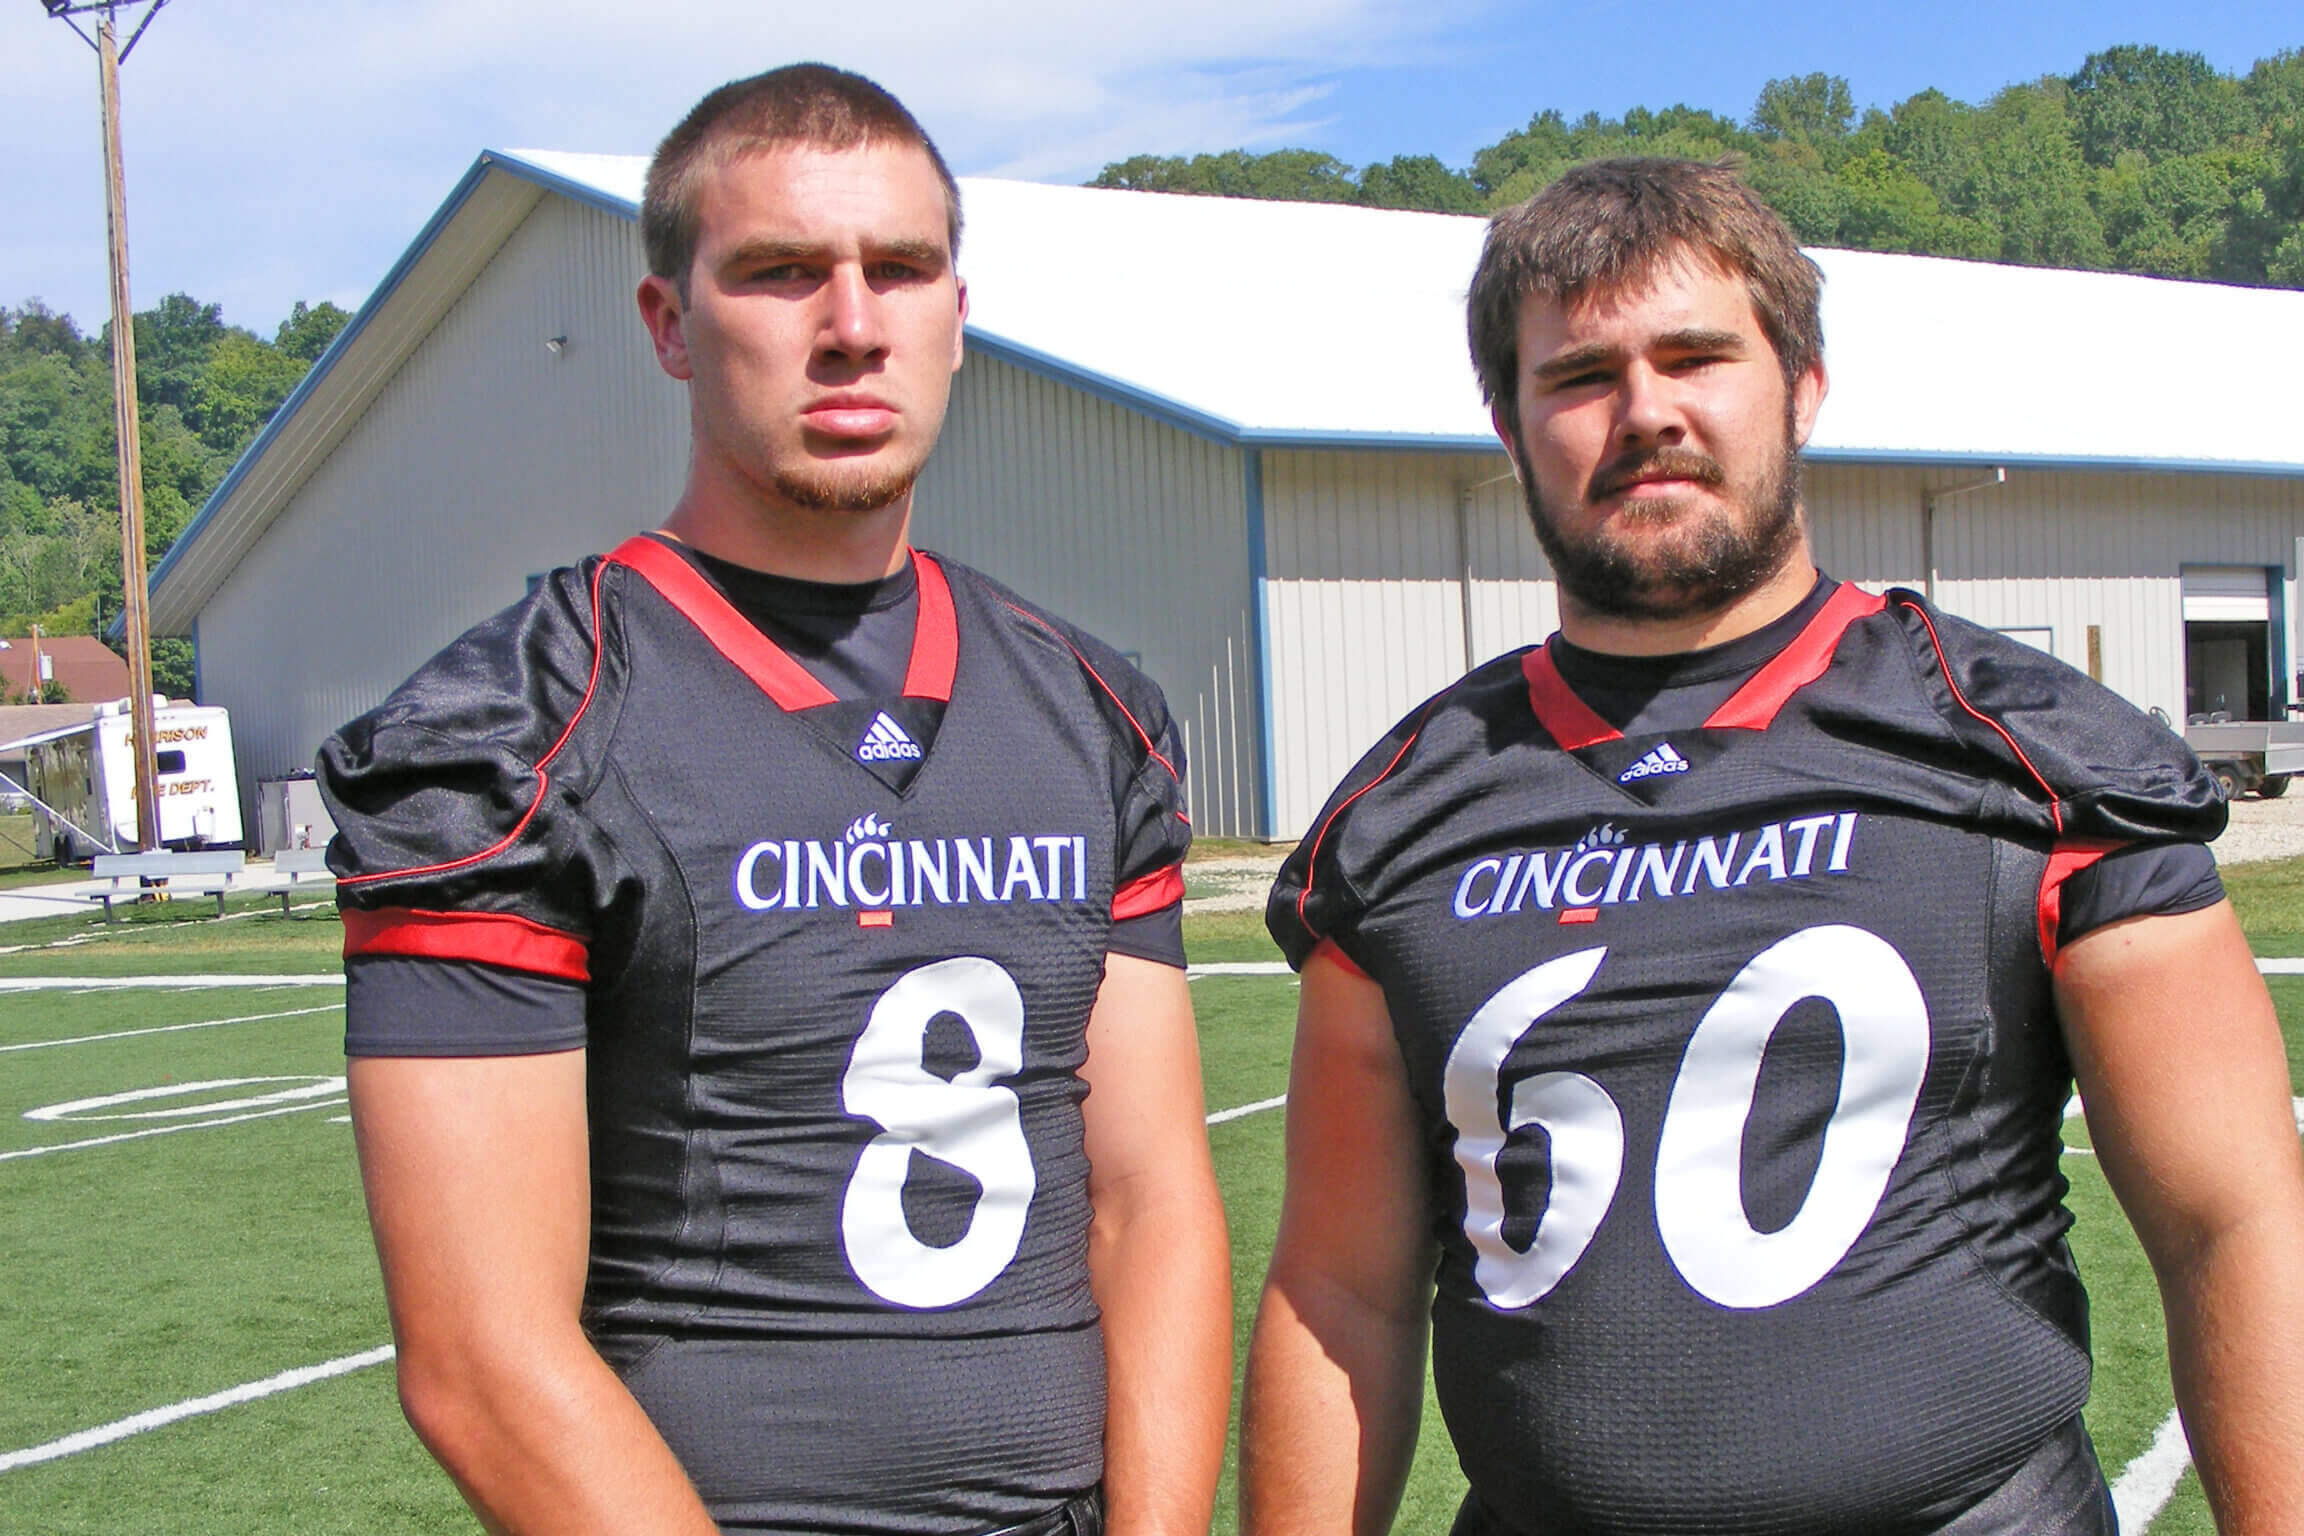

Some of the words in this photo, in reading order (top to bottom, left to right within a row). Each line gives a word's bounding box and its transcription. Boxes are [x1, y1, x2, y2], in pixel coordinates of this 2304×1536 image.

[124, 725, 209, 747] HRISON
[858, 740, 922, 761] adidas
[169, 778, 215, 796] DEPT.
[1619, 759, 1690, 783] adidas
[734, 833, 1088, 912] CINCINNATI
[1452, 811, 1860, 920] CINCINNATI
[841, 954, 1038, 1310] 8
[1443, 922, 1932, 1311] 60
